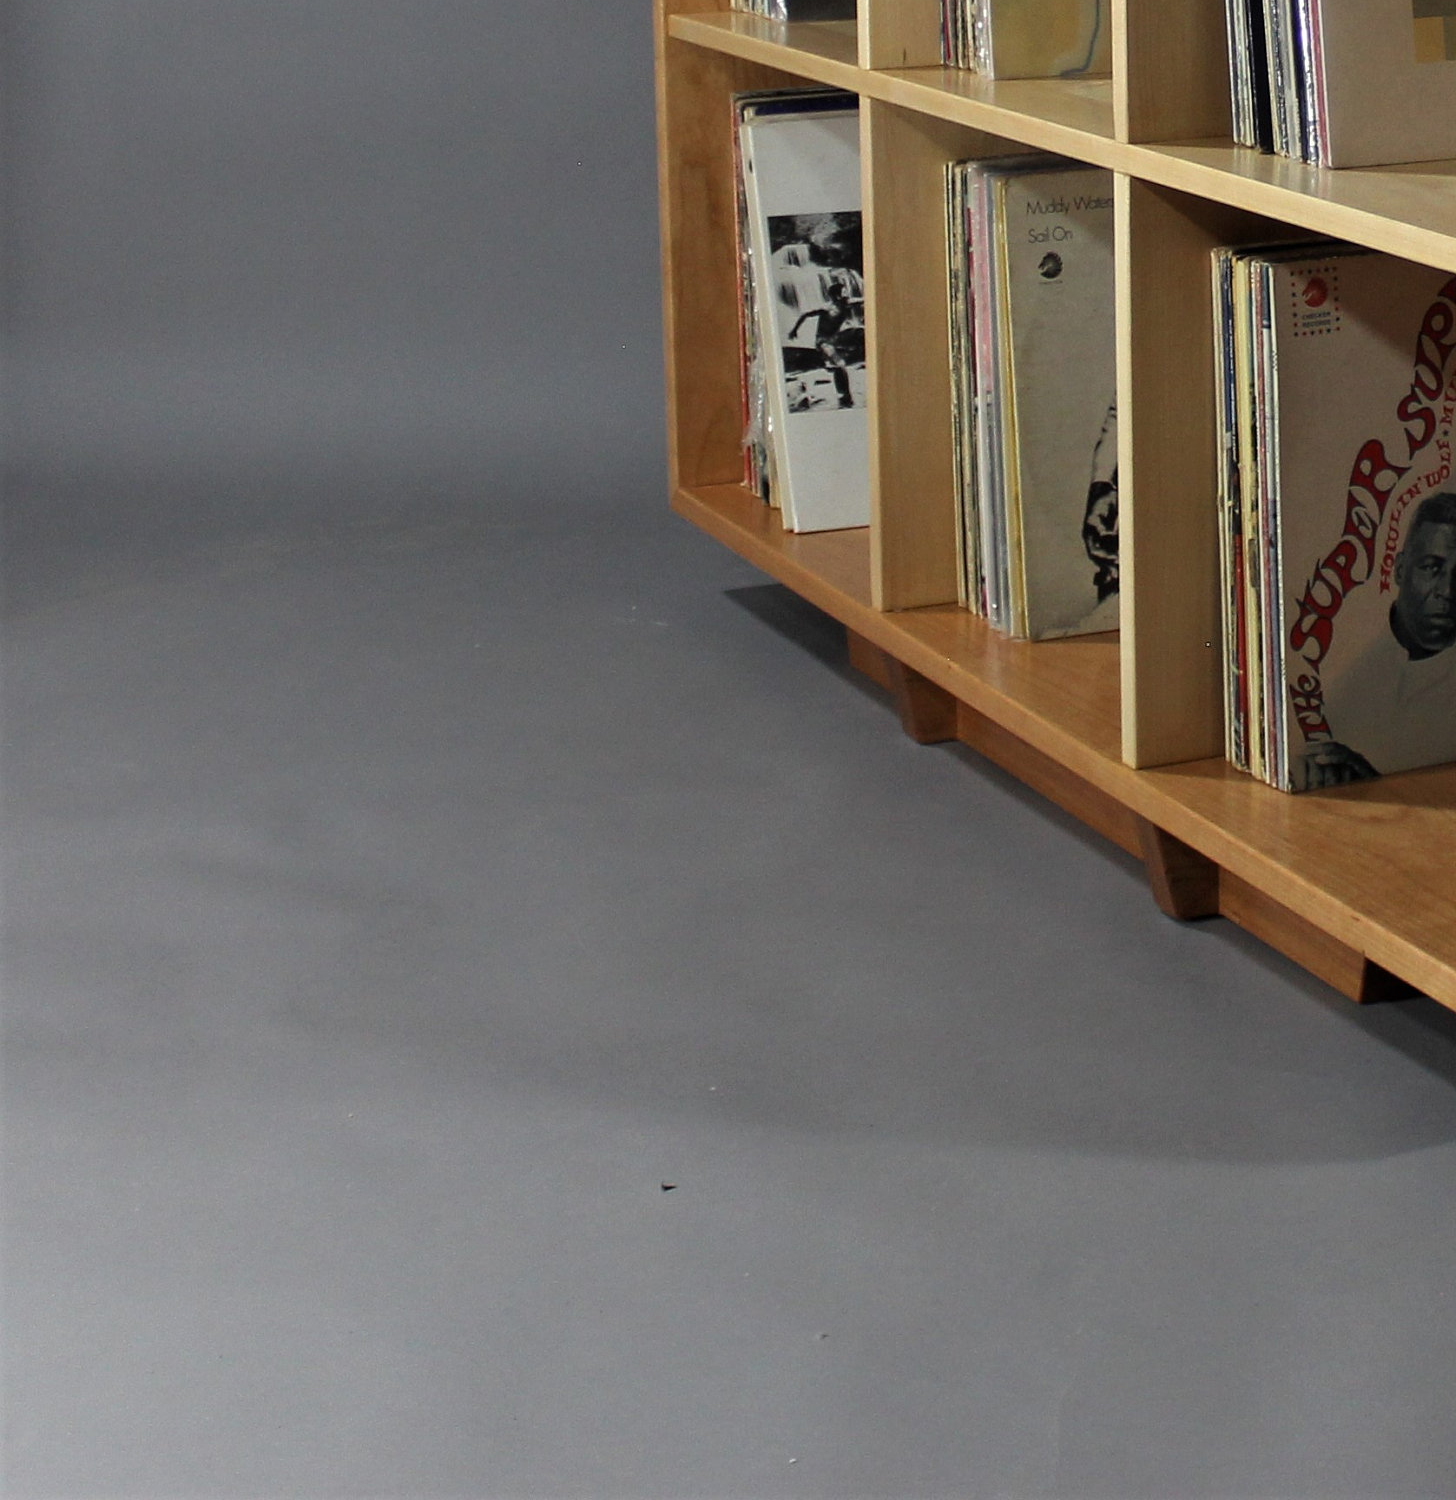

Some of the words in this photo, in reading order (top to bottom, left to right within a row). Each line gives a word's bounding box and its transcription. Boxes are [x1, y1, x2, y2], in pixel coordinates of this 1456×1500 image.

[1026, 196, 1070, 216] Muddy
[1053, 226, 1073, 242] On
[1290, 439, 1412, 675] SUPER
